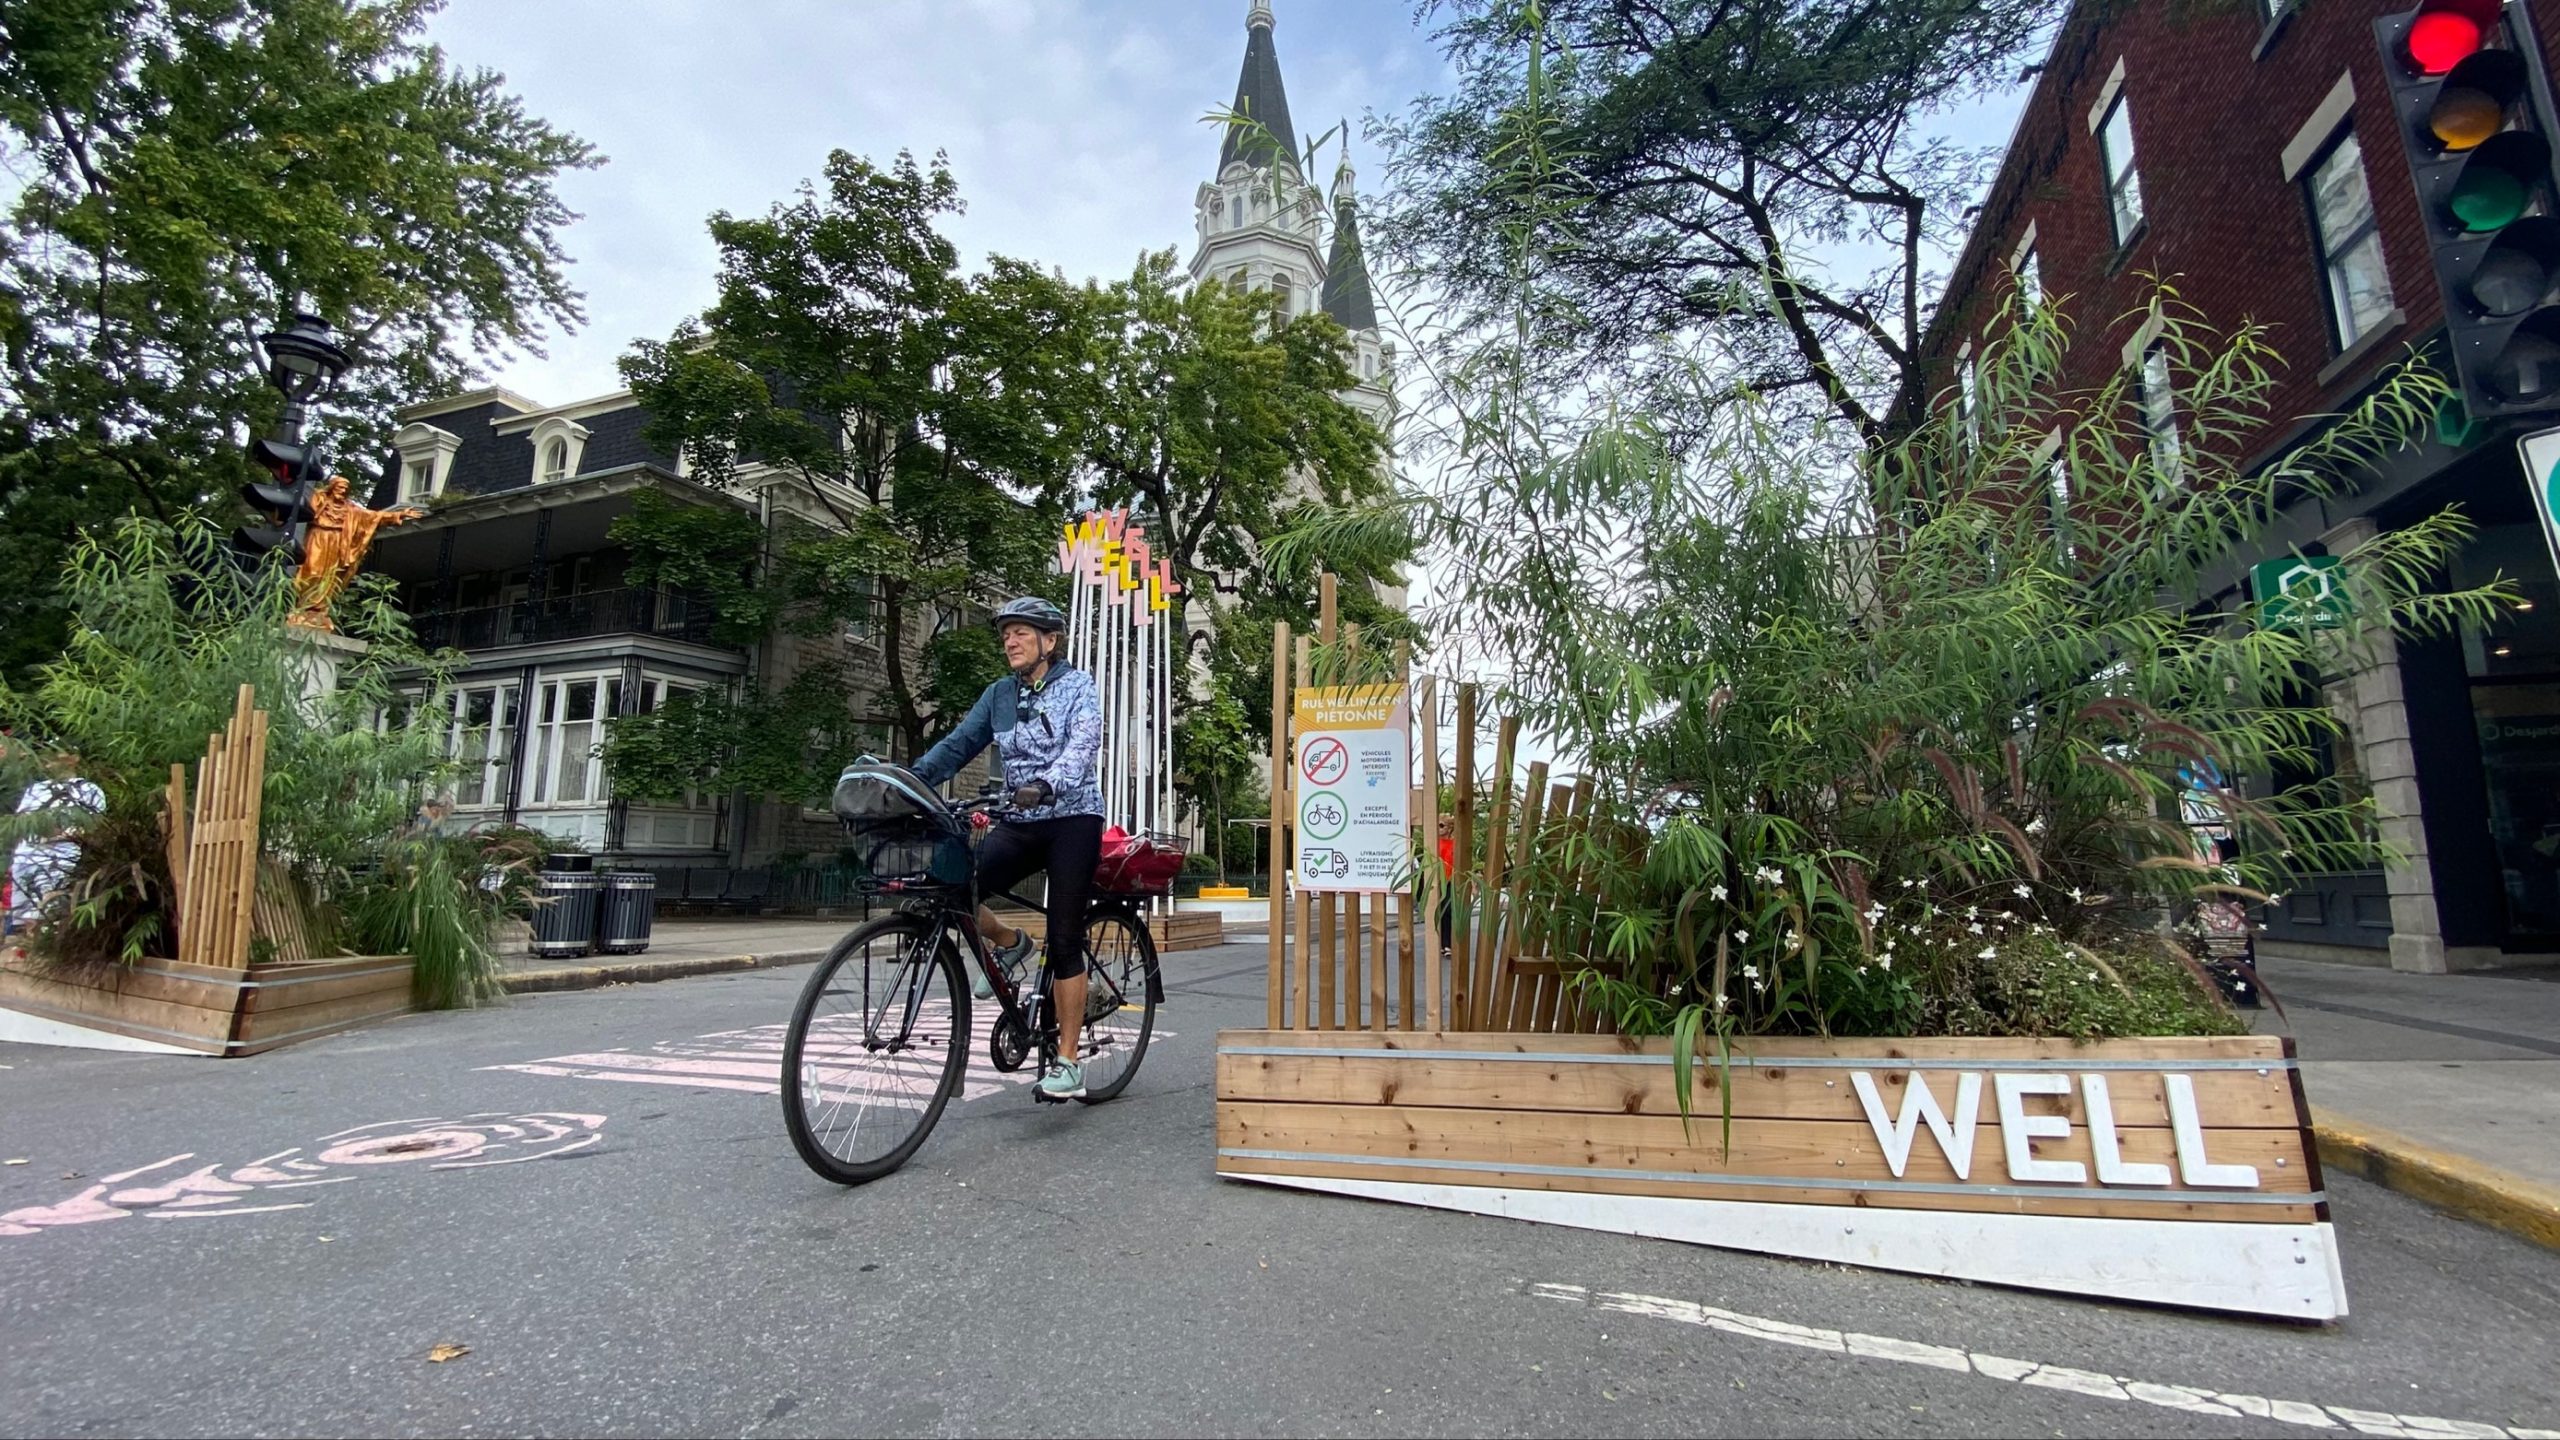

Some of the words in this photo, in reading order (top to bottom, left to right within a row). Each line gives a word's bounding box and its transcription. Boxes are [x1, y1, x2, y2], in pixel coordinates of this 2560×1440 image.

[1302, 698, 1324, 709] RUE
[1316, 708, 1386, 723] PIÉTONNE
[1849, 1071, 2260, 1188] WELL
